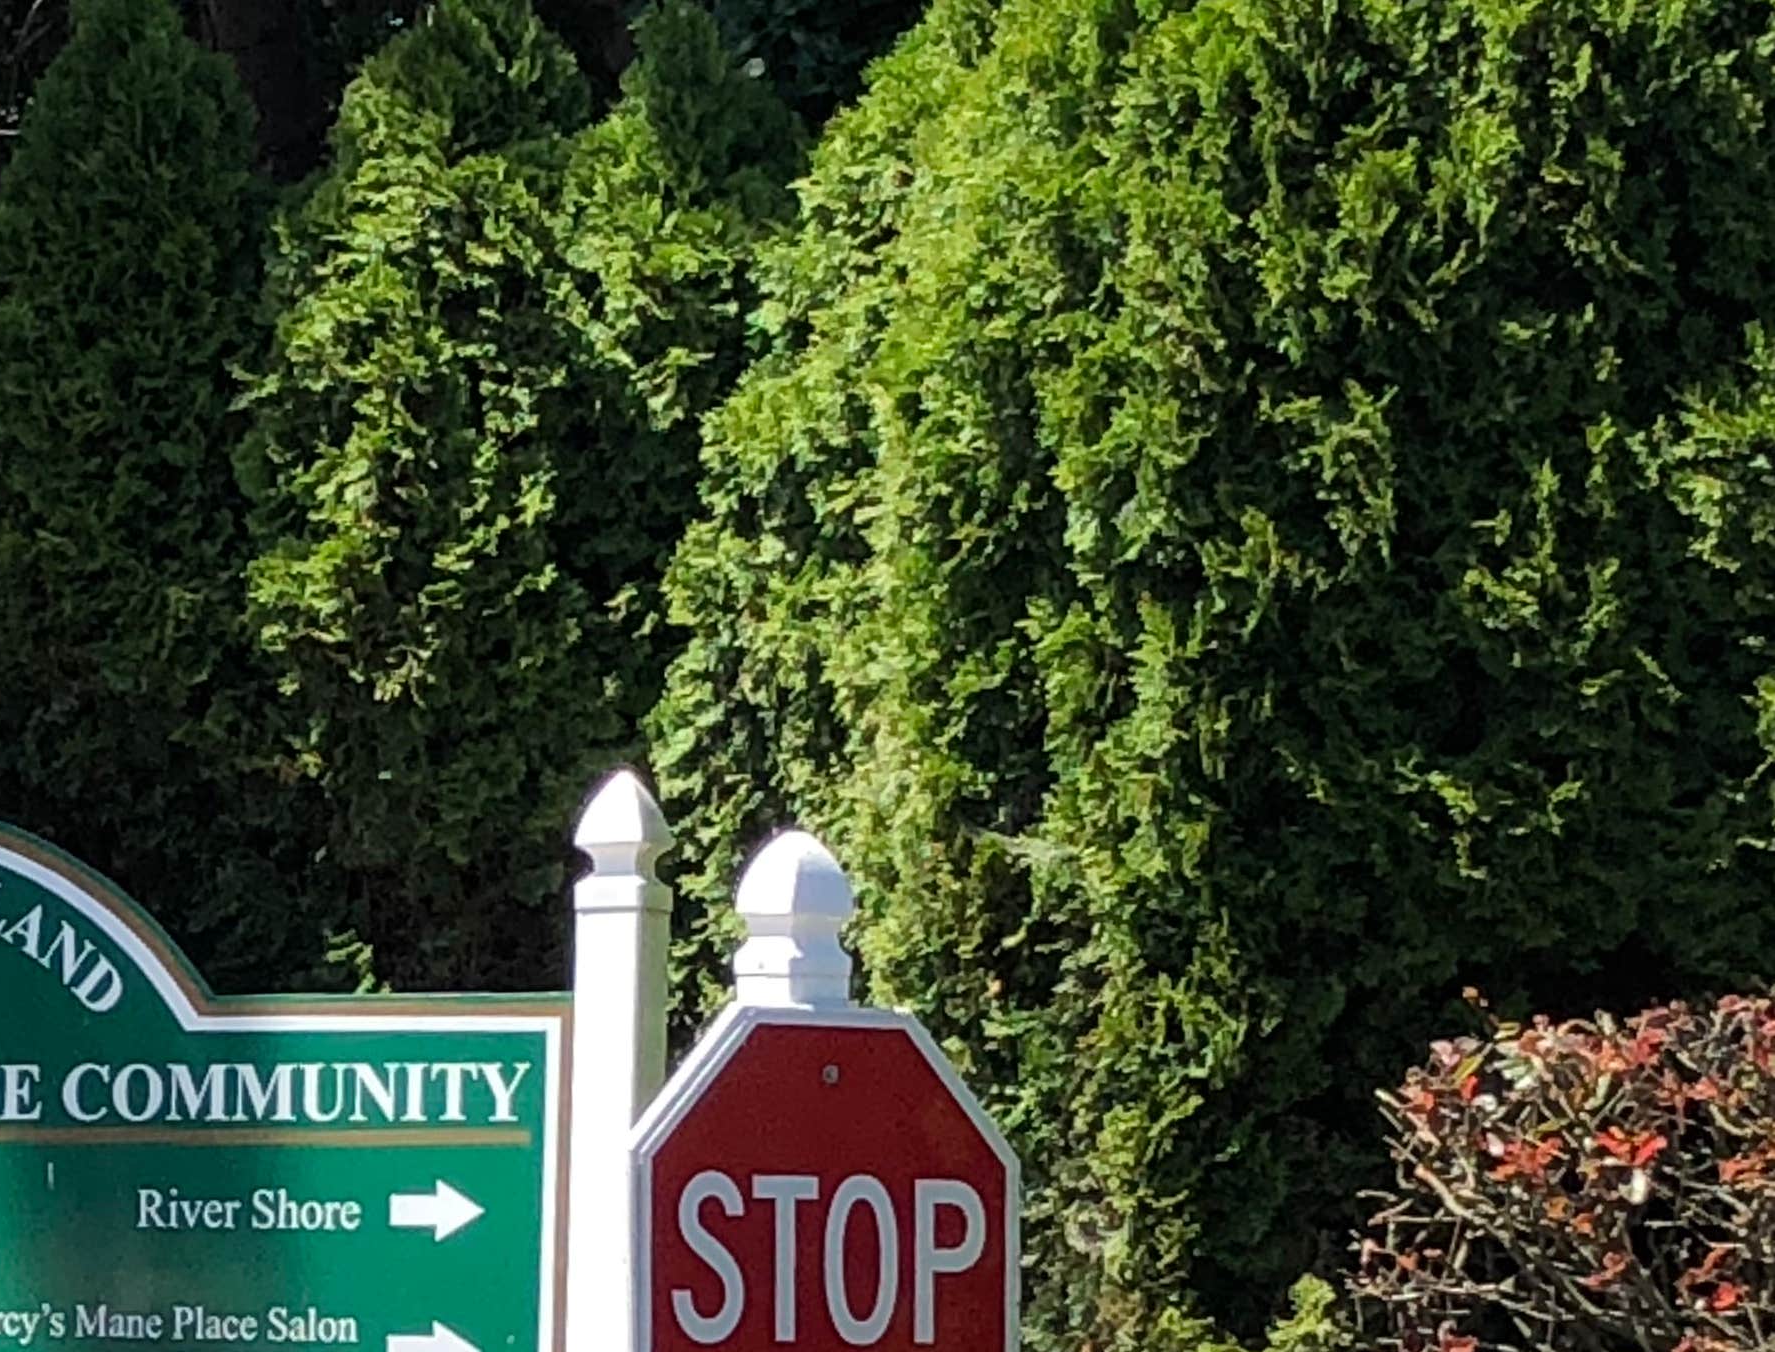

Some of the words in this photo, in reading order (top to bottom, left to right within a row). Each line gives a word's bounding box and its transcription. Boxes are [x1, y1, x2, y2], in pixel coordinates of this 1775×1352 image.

[62, 1061, 531, 1123] COMMUNITY
[137, 1189, 241, 1230] River
[251, 1189, 361, 1232] Shore
[671, 1170, 986, 1346] STOP
[75, 1305, 162, 1340] Mane
[172, 1306, 258, 1342] Place
[267, 1307, 358, 1343] Salon
